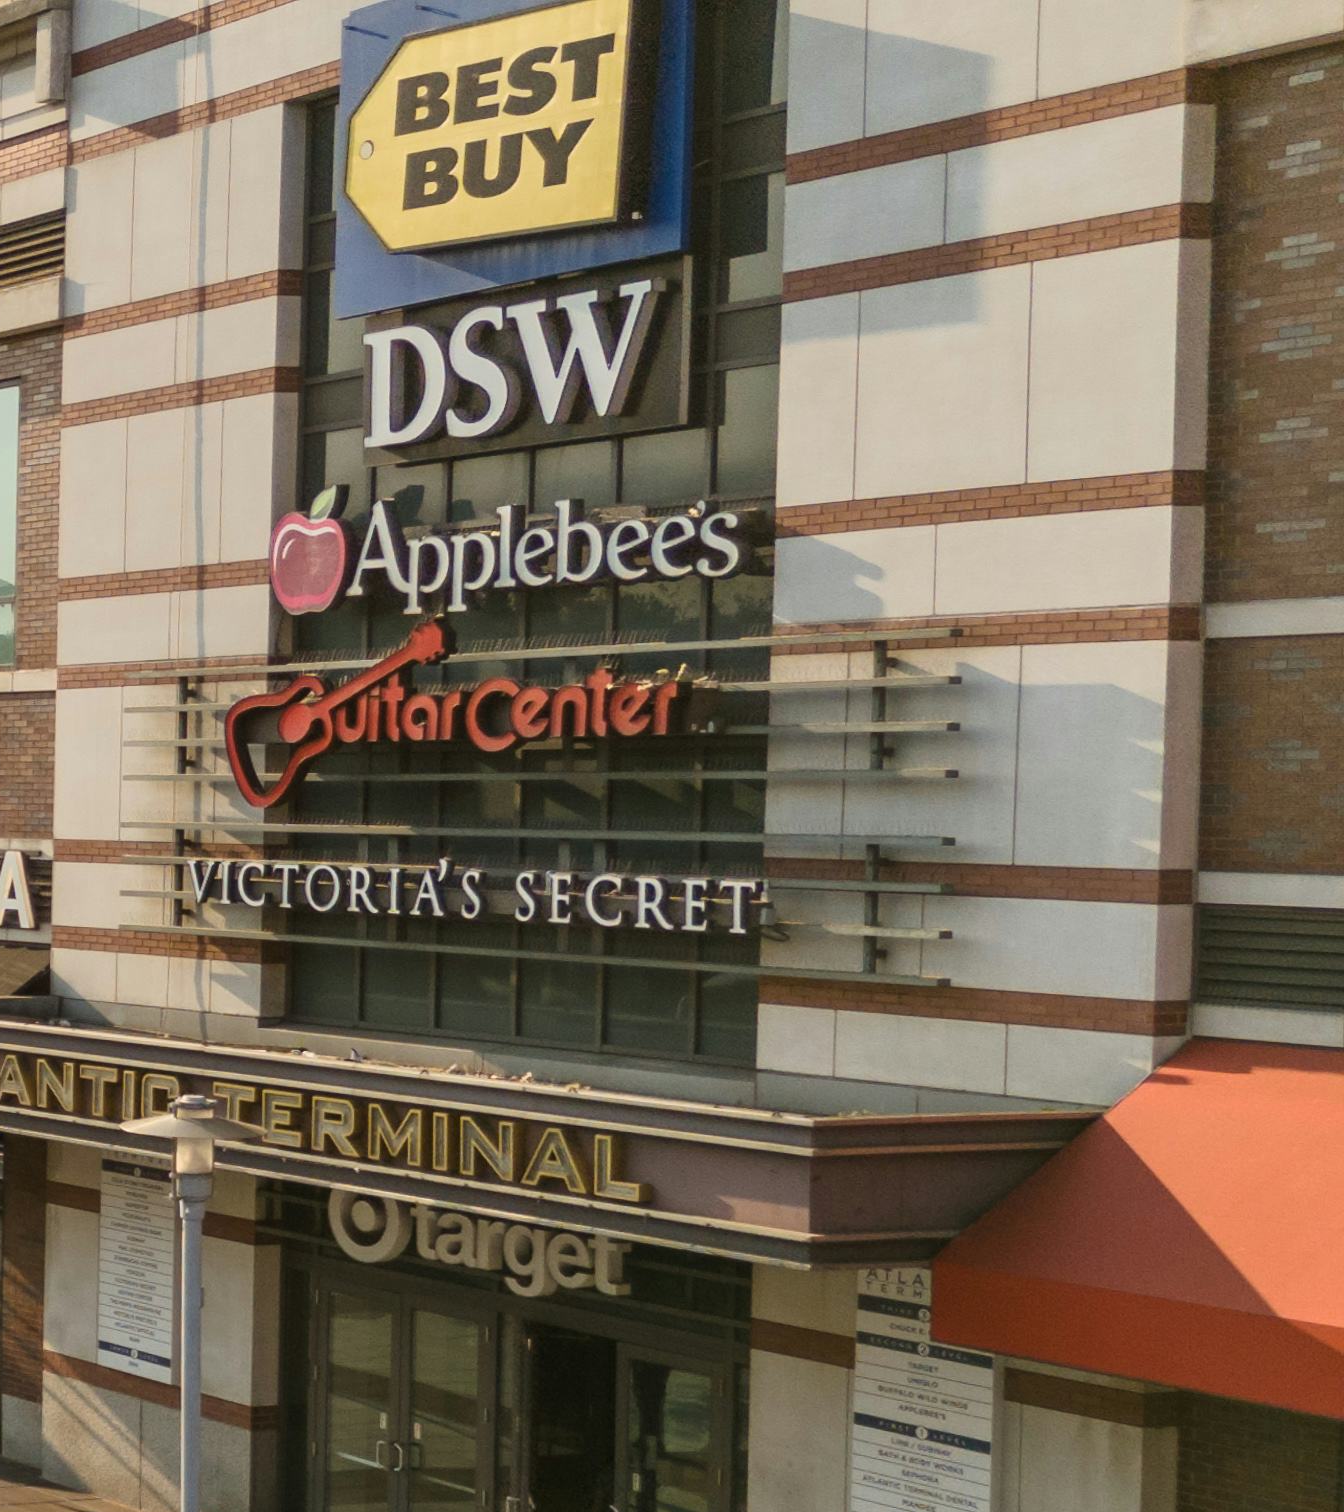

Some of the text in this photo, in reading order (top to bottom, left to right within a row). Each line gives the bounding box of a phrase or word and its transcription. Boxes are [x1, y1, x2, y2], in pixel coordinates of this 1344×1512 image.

[394, 33, 615, 137] BEST
[402, 119, 595, 211] BUY
[363, 279, 658, 450] DSW
[346, 498, 739, 615] Applebee's
[465, 667, 678, 752] Center
[187, 857, 765, 936] VICTORIA'S SECRET
[213, 1082, 652, 1203] TERMINAL
[410, 1203, 632, 1298] target
[866, 1267, 925, 1288] ATLA
[866, 1281, 923, 1299] TERM
